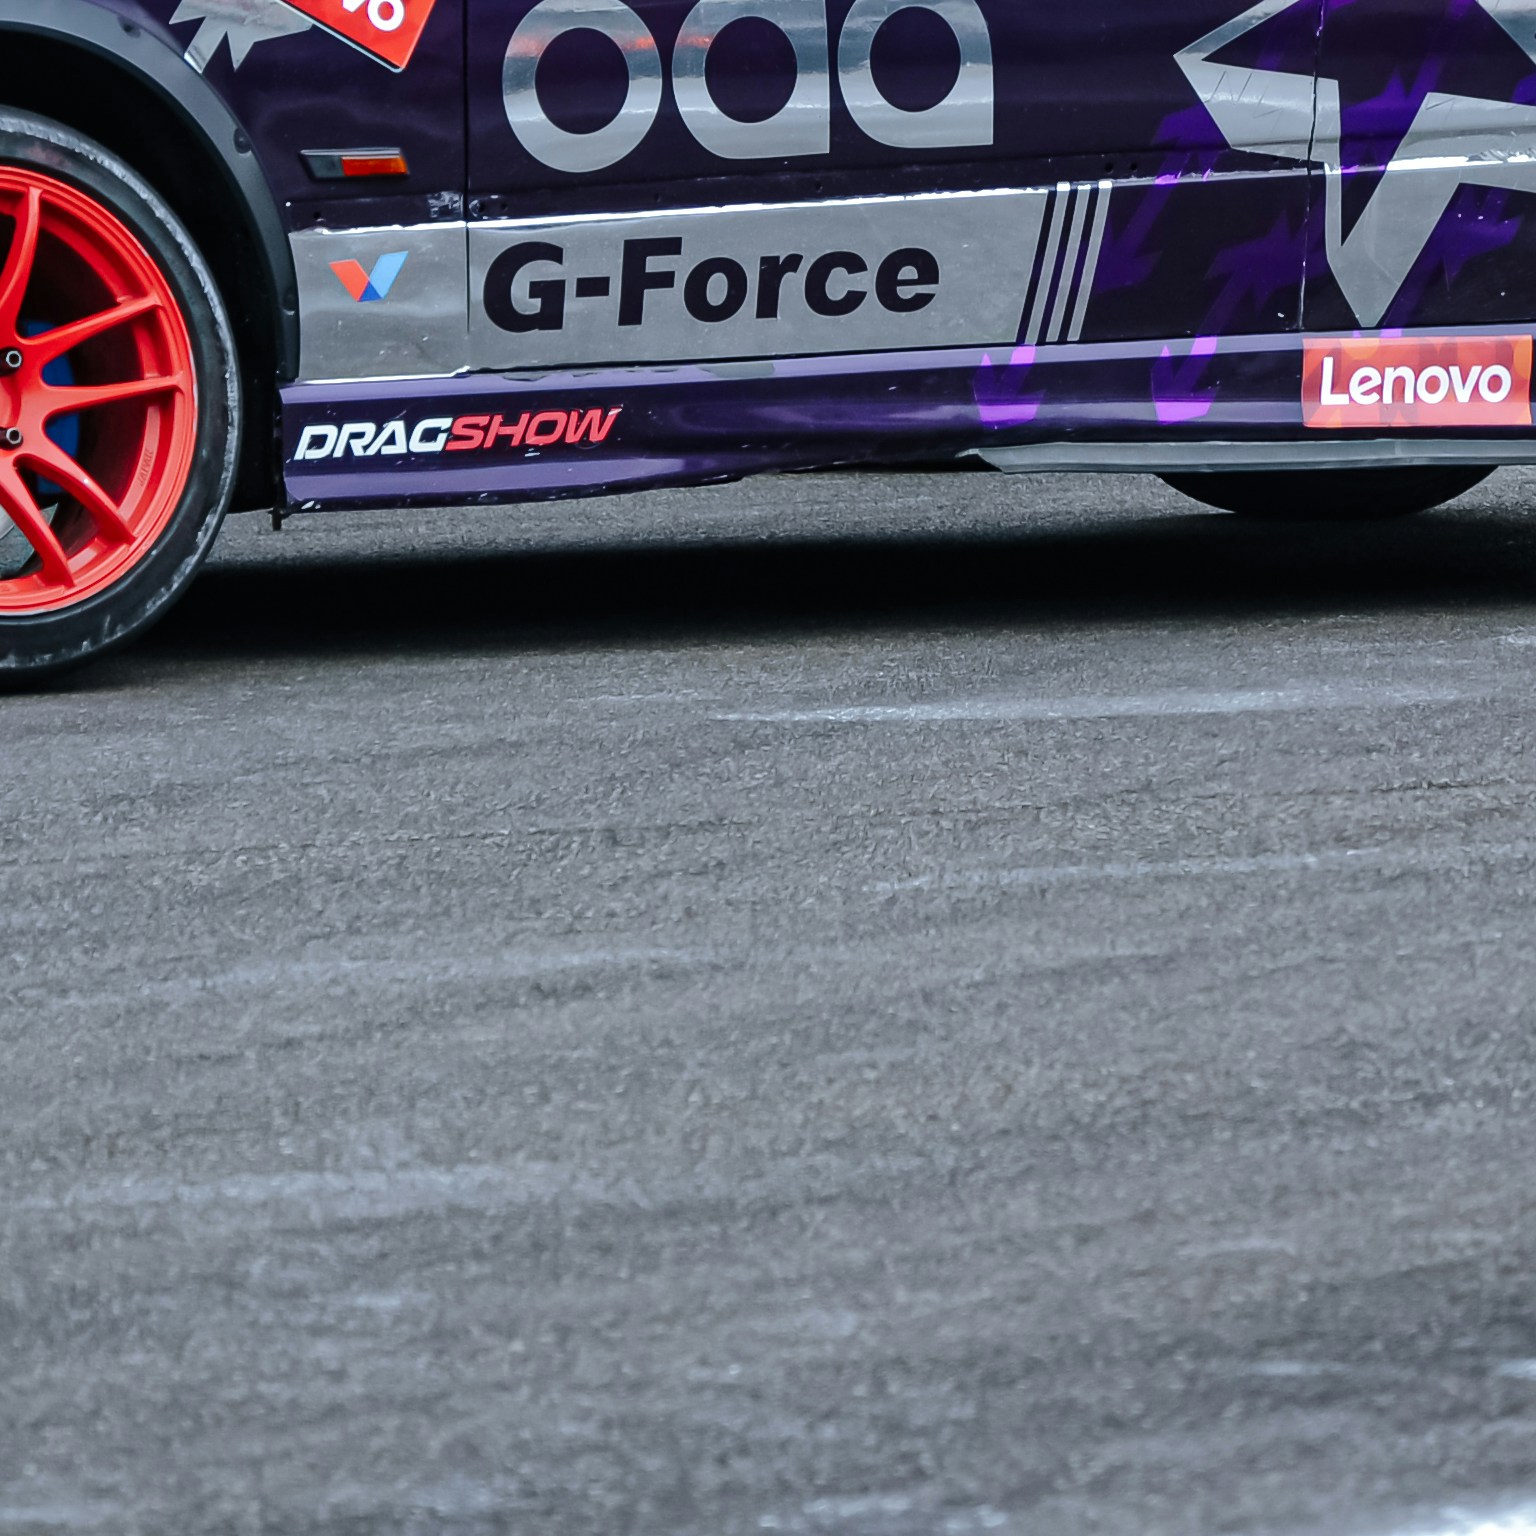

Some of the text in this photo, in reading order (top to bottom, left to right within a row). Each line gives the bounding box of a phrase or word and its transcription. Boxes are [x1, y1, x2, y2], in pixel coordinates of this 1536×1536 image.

[482, 235, 941, 334] G-Force
[1320, 356, 1513, 406] Lenovo
[293, 406, 621, 460] DRAGSHOW
